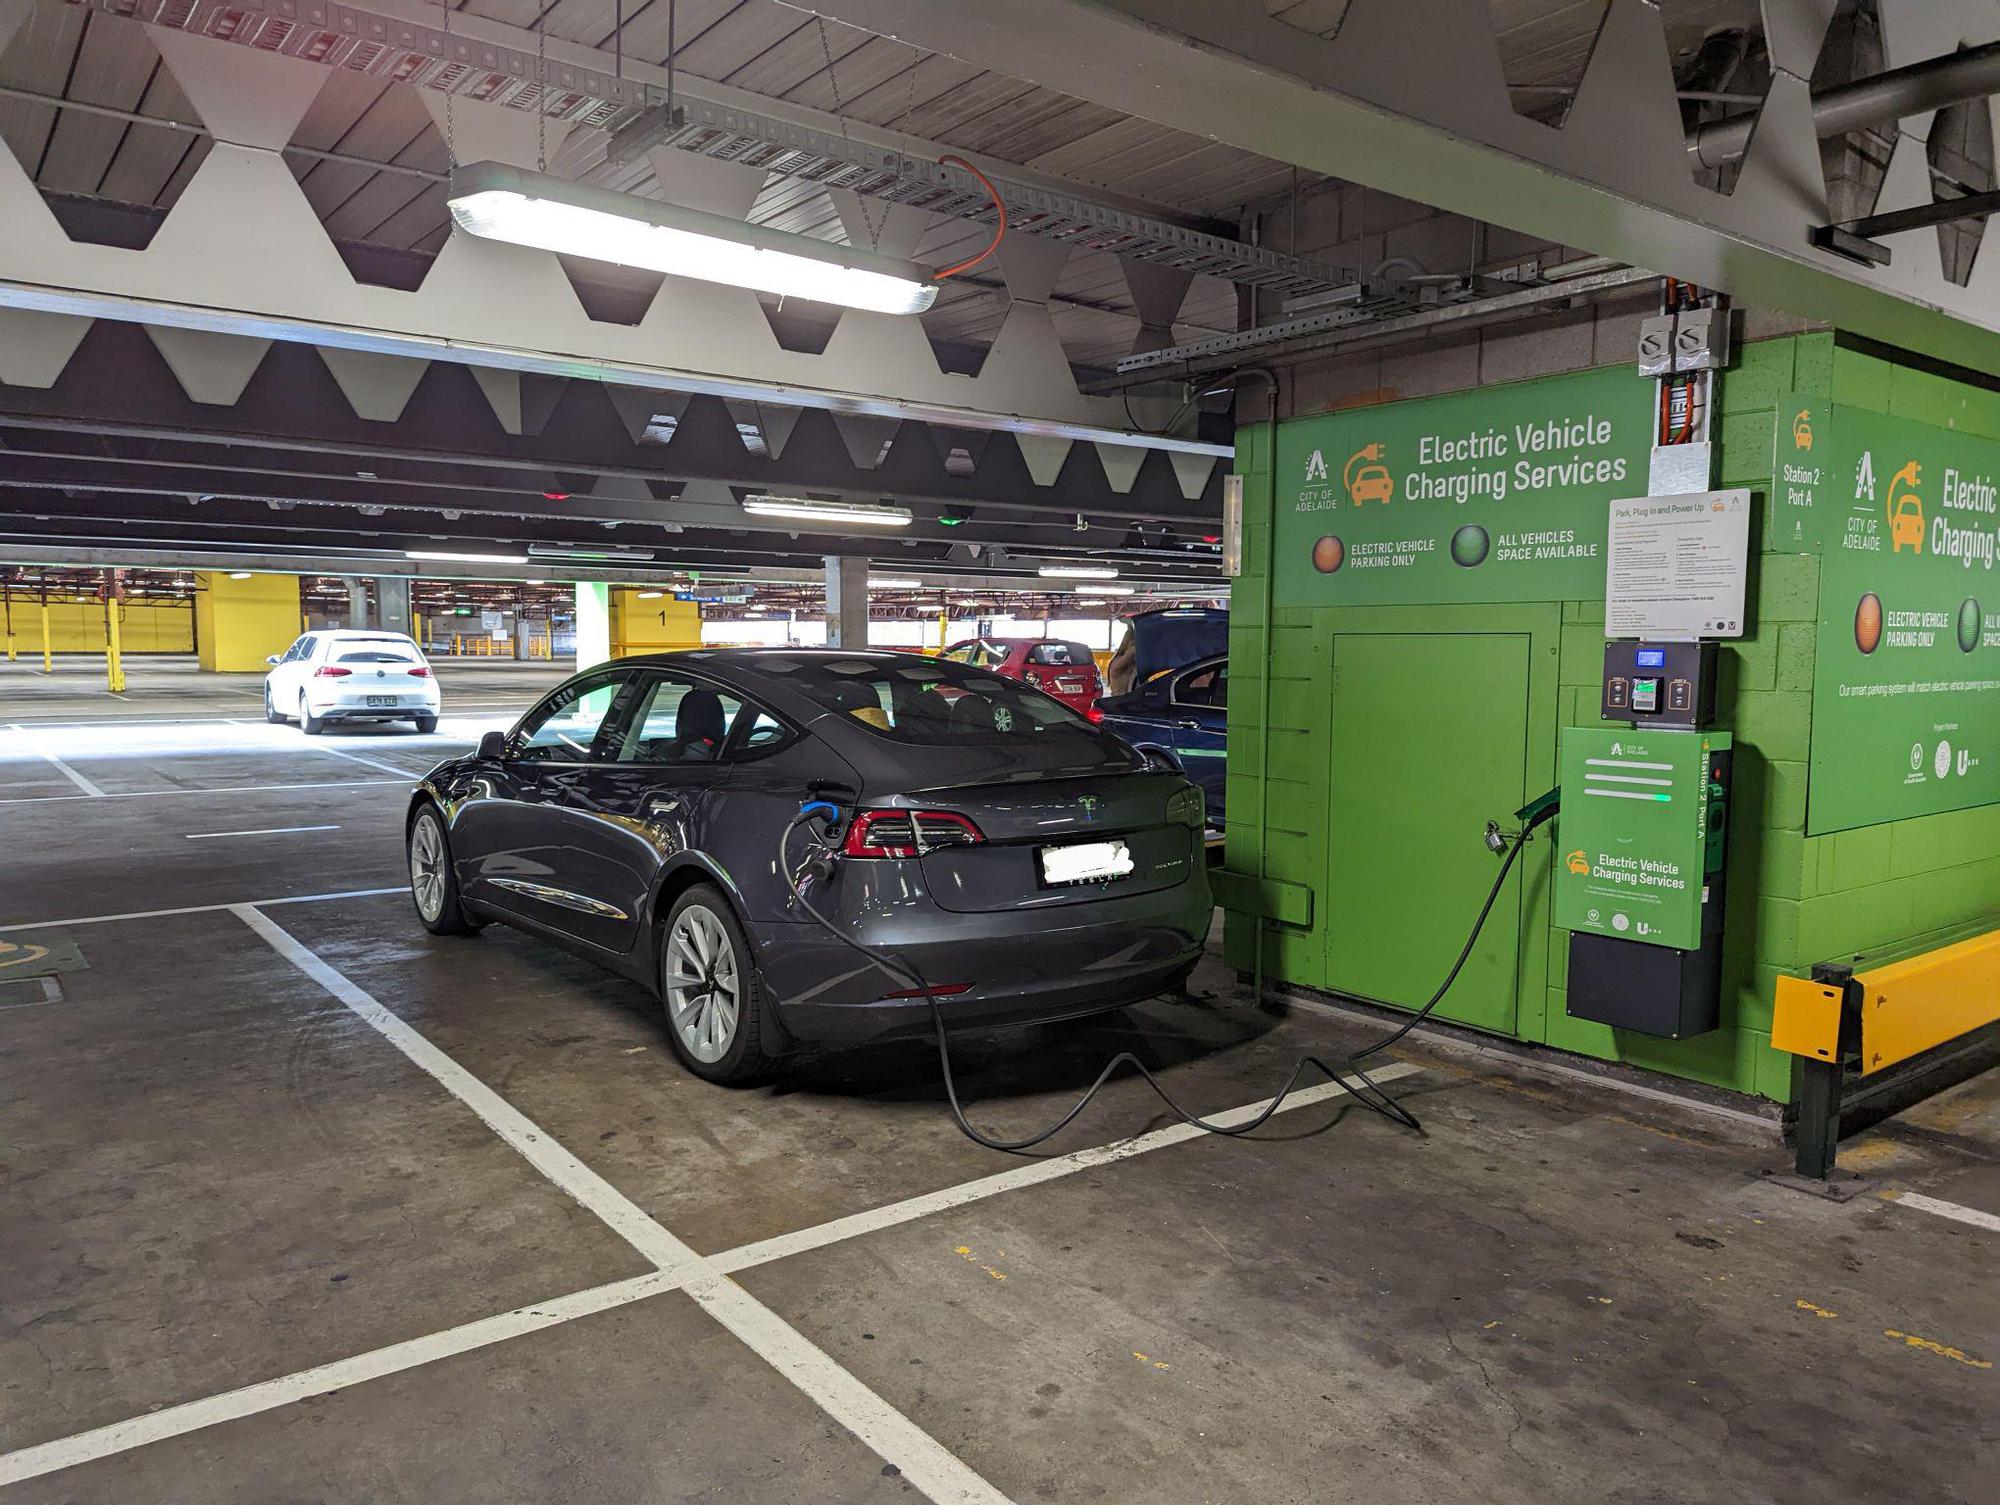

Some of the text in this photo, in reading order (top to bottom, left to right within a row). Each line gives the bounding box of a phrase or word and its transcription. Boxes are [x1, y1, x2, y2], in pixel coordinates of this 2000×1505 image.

[1419, 414, 1612, 465] Electric Vehicle
[1405, 454, 1627, 504] Charging Services
[1783, 464, 1820, 485] Station 2
[1299, 489, 1333, 502] CITY OF
[1788, 487, 1812, 507] Port A
[1943, 468, 1997, 514] Electric
[1295, 499, 1338, 512] ADELAIDE
[1633, 508, 1648, 517] Plug
[1649, 507, 1657, 515] in
[1657, 505, 1671, 514] and
[1671, 504, 1693, 513] Power
[1694, 503, 1704, 513] Up
[1847, 517, 1878, 533] CITY OF
[1498, 530, 1574, 547] ALL VEHICLES
[1842, 534, 1880, 551] ADELAIDE
[1931, 516, 1995, 570] Charging
[1351, 539, 1435, 556] ELECTRIC VEHICLE
[1497, 544, 1598, 560] SPACE AVAILABLE
[1351, 554, 1415, 568] PARKING ONLY
[658, 610, 666, 626] 1
[1887, 611, 1949, 628] ELECTRIC VEHICLE
[1886, 631, 1935, 647] PARKING ONLY
[1839, 684, 1850, 696] Our
[1850, 685, 1867, 696] smart
[1867, 684, 1887, 698] parking
[1700, 753, 1709, 792] Station
[1698, 806, 1706, 828] Port
[1697, 831, 1705, 839] A
[1599, 853, 1679, 875] Electric Vehicle
[1068, 874, 1113, 885] TESLA
[1593, 866, 1685, 889] Charging Services
